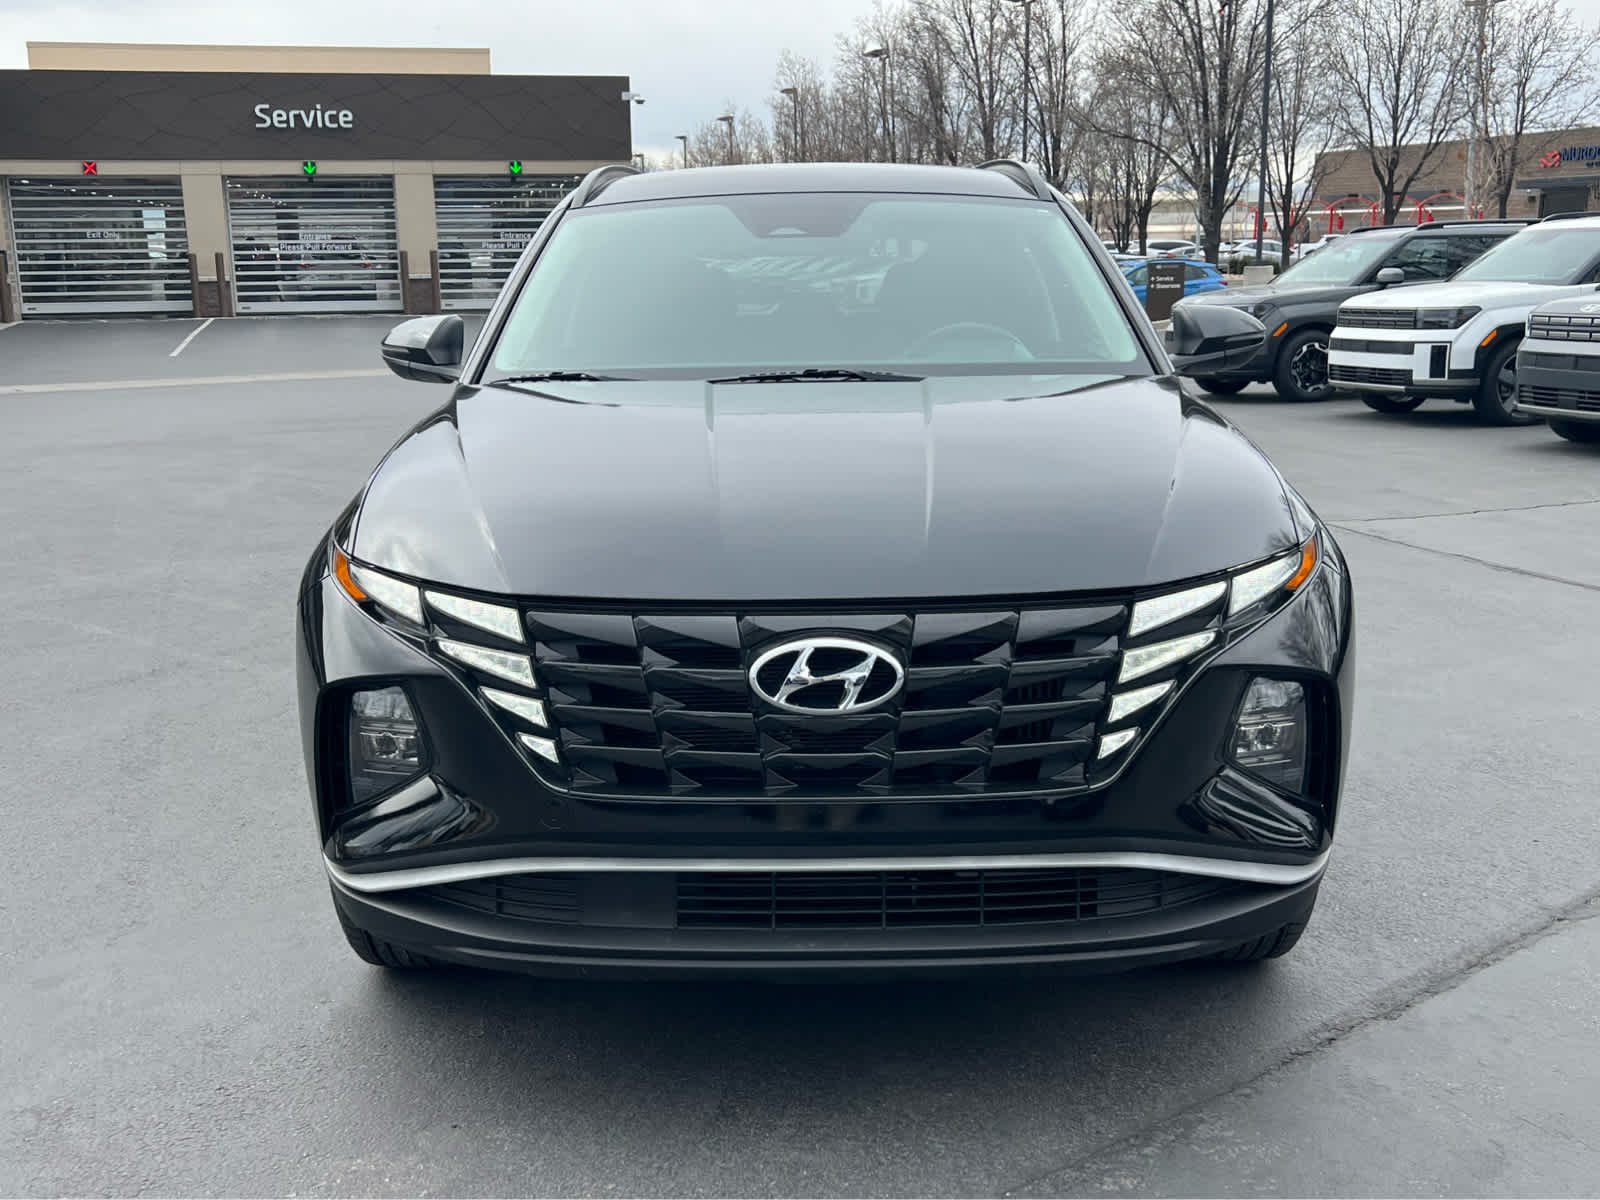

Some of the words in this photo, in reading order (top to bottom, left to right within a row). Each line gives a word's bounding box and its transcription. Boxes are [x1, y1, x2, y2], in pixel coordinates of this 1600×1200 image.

[254, 103, 354, 129] Service
[86, 231, 102, 239] Exit
[103, 231, 120, 241] Only
[500, 231, 532, 240] Entrance
[280, 242, 304, 251] Please
[305, 242, 320, 251] Pull
[322, 242, 353, 251] Forward
[481, 240, 505, 249] Please
[506, 240, 520, 249] Pull
